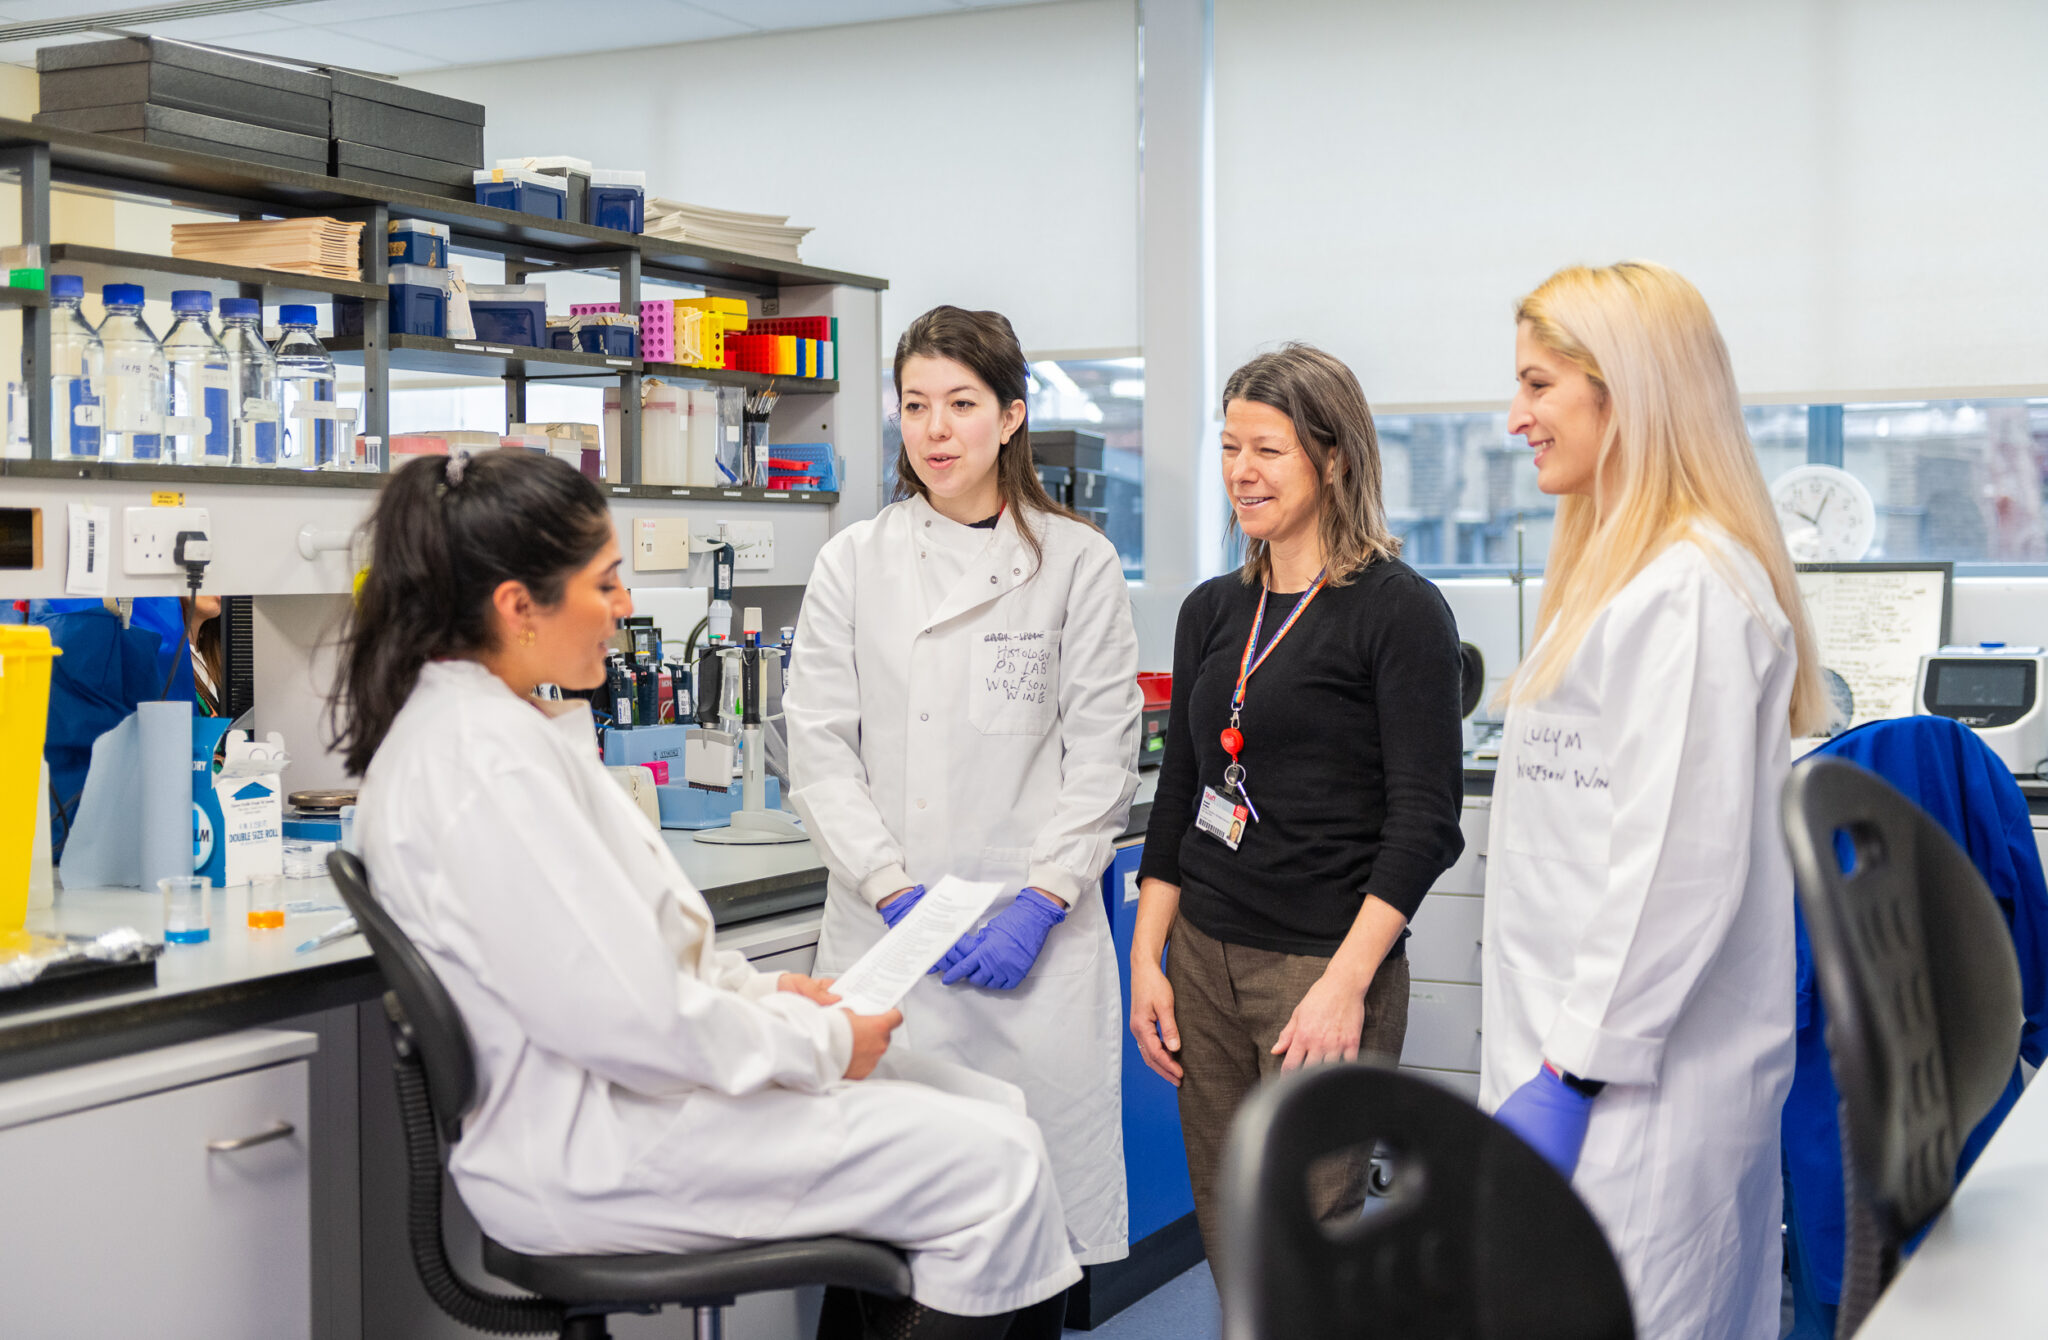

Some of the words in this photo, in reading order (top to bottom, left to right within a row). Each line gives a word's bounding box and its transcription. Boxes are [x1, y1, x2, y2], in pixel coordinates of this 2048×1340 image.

[1021, 660, 1048, 676] LAB
[985, 675, 1048, 692] WOLFSON
[1523, 727, 1562, 757] LUCY
